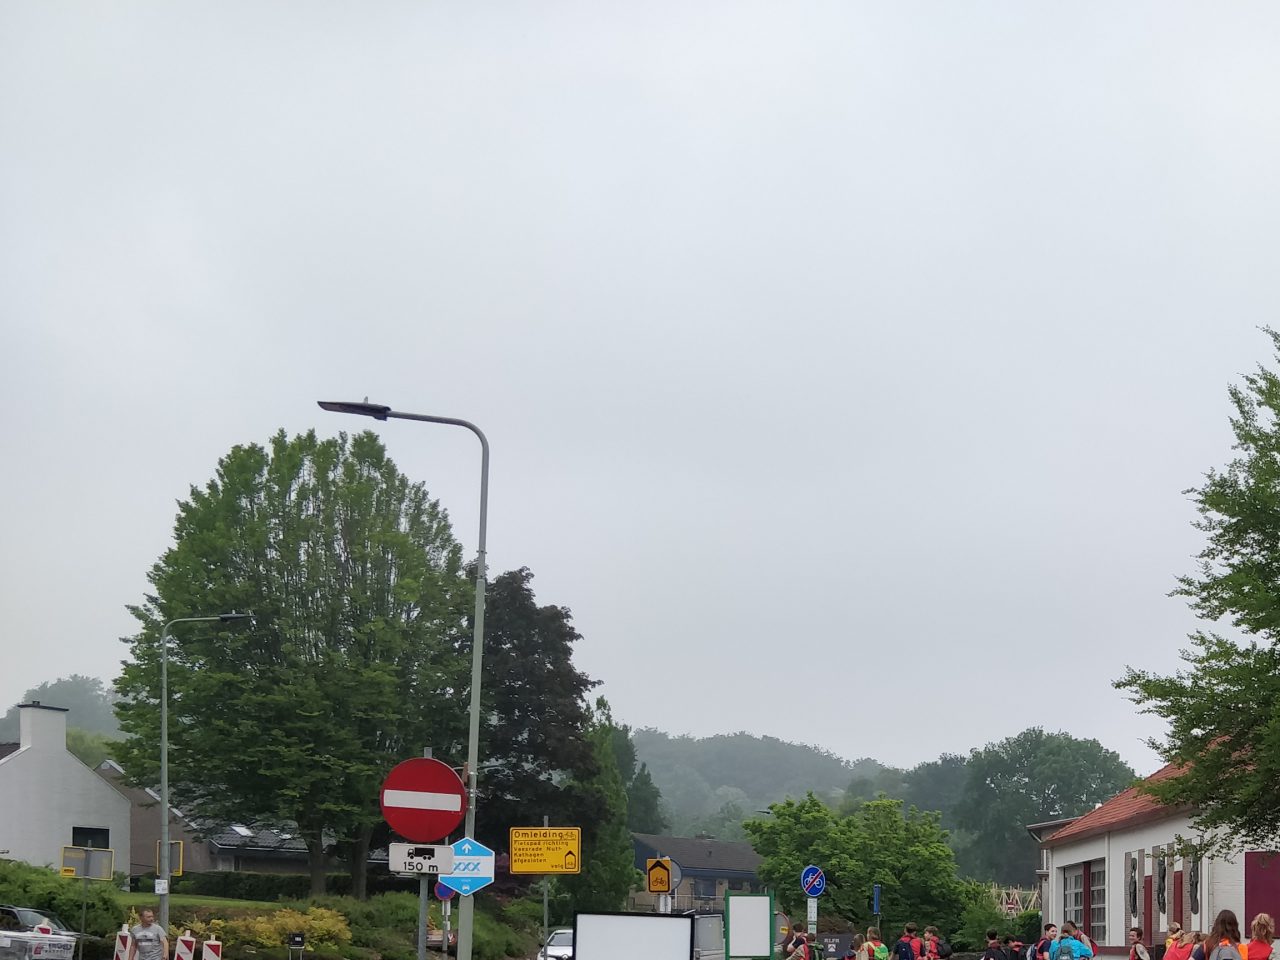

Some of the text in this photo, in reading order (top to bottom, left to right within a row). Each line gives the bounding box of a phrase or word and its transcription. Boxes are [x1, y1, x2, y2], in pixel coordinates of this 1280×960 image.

[514, 831, 563, 840] Omleiding
[403, 861, 439, 872] 150 m
